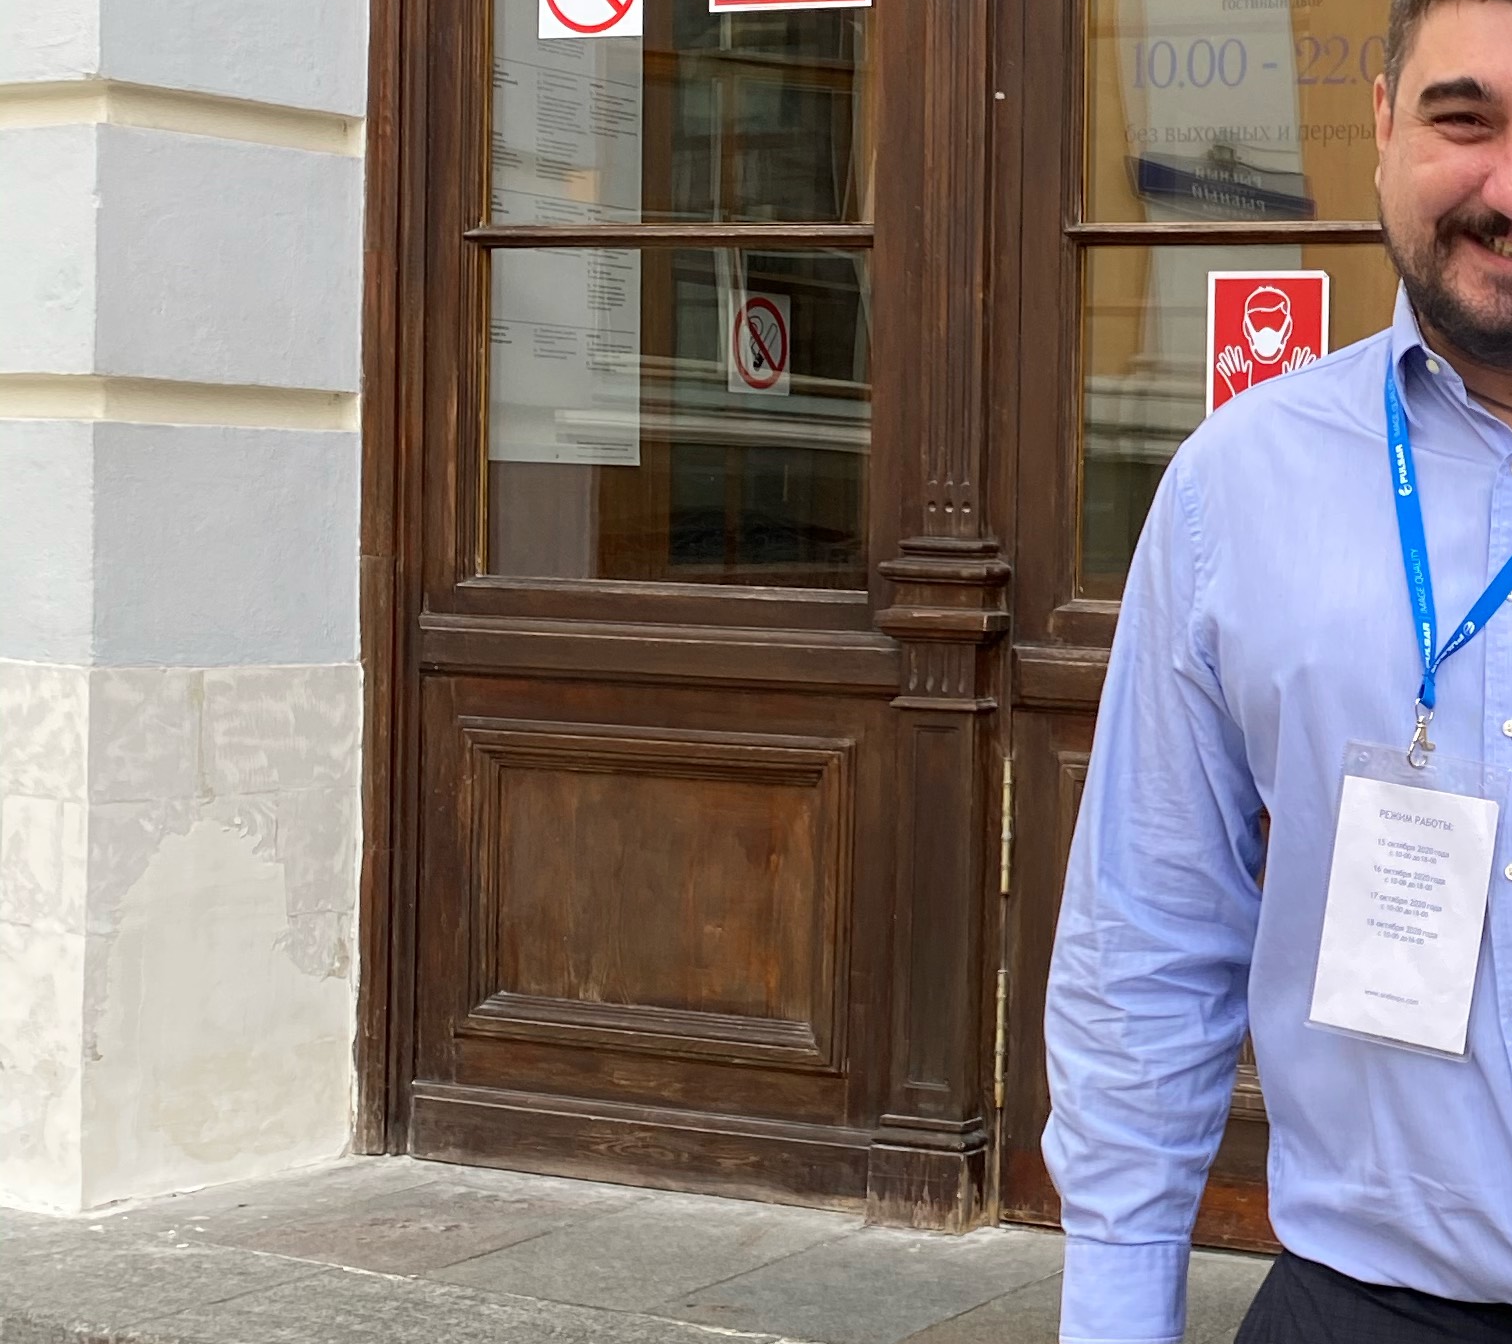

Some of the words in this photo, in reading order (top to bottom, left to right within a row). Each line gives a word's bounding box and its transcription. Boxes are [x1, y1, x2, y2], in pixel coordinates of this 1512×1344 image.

[1132, 38, 1248, 89] 10.00
[1295, 35, 1388, 86] 22.0
[1125, 125, 1159, 144] без
[1165, 126, 1271, 144] выходных
[1277, 127, 1290, 142] и
[1298, 124, 1376, 147] переры
[1395, 443, 1408, 484] PULSAR
[1410, 548, 1425, 584] QUALITY
[1416, 586, 1428, 614] IMAGE
[1379, 809, 1413, 823] РЕЖИМ
